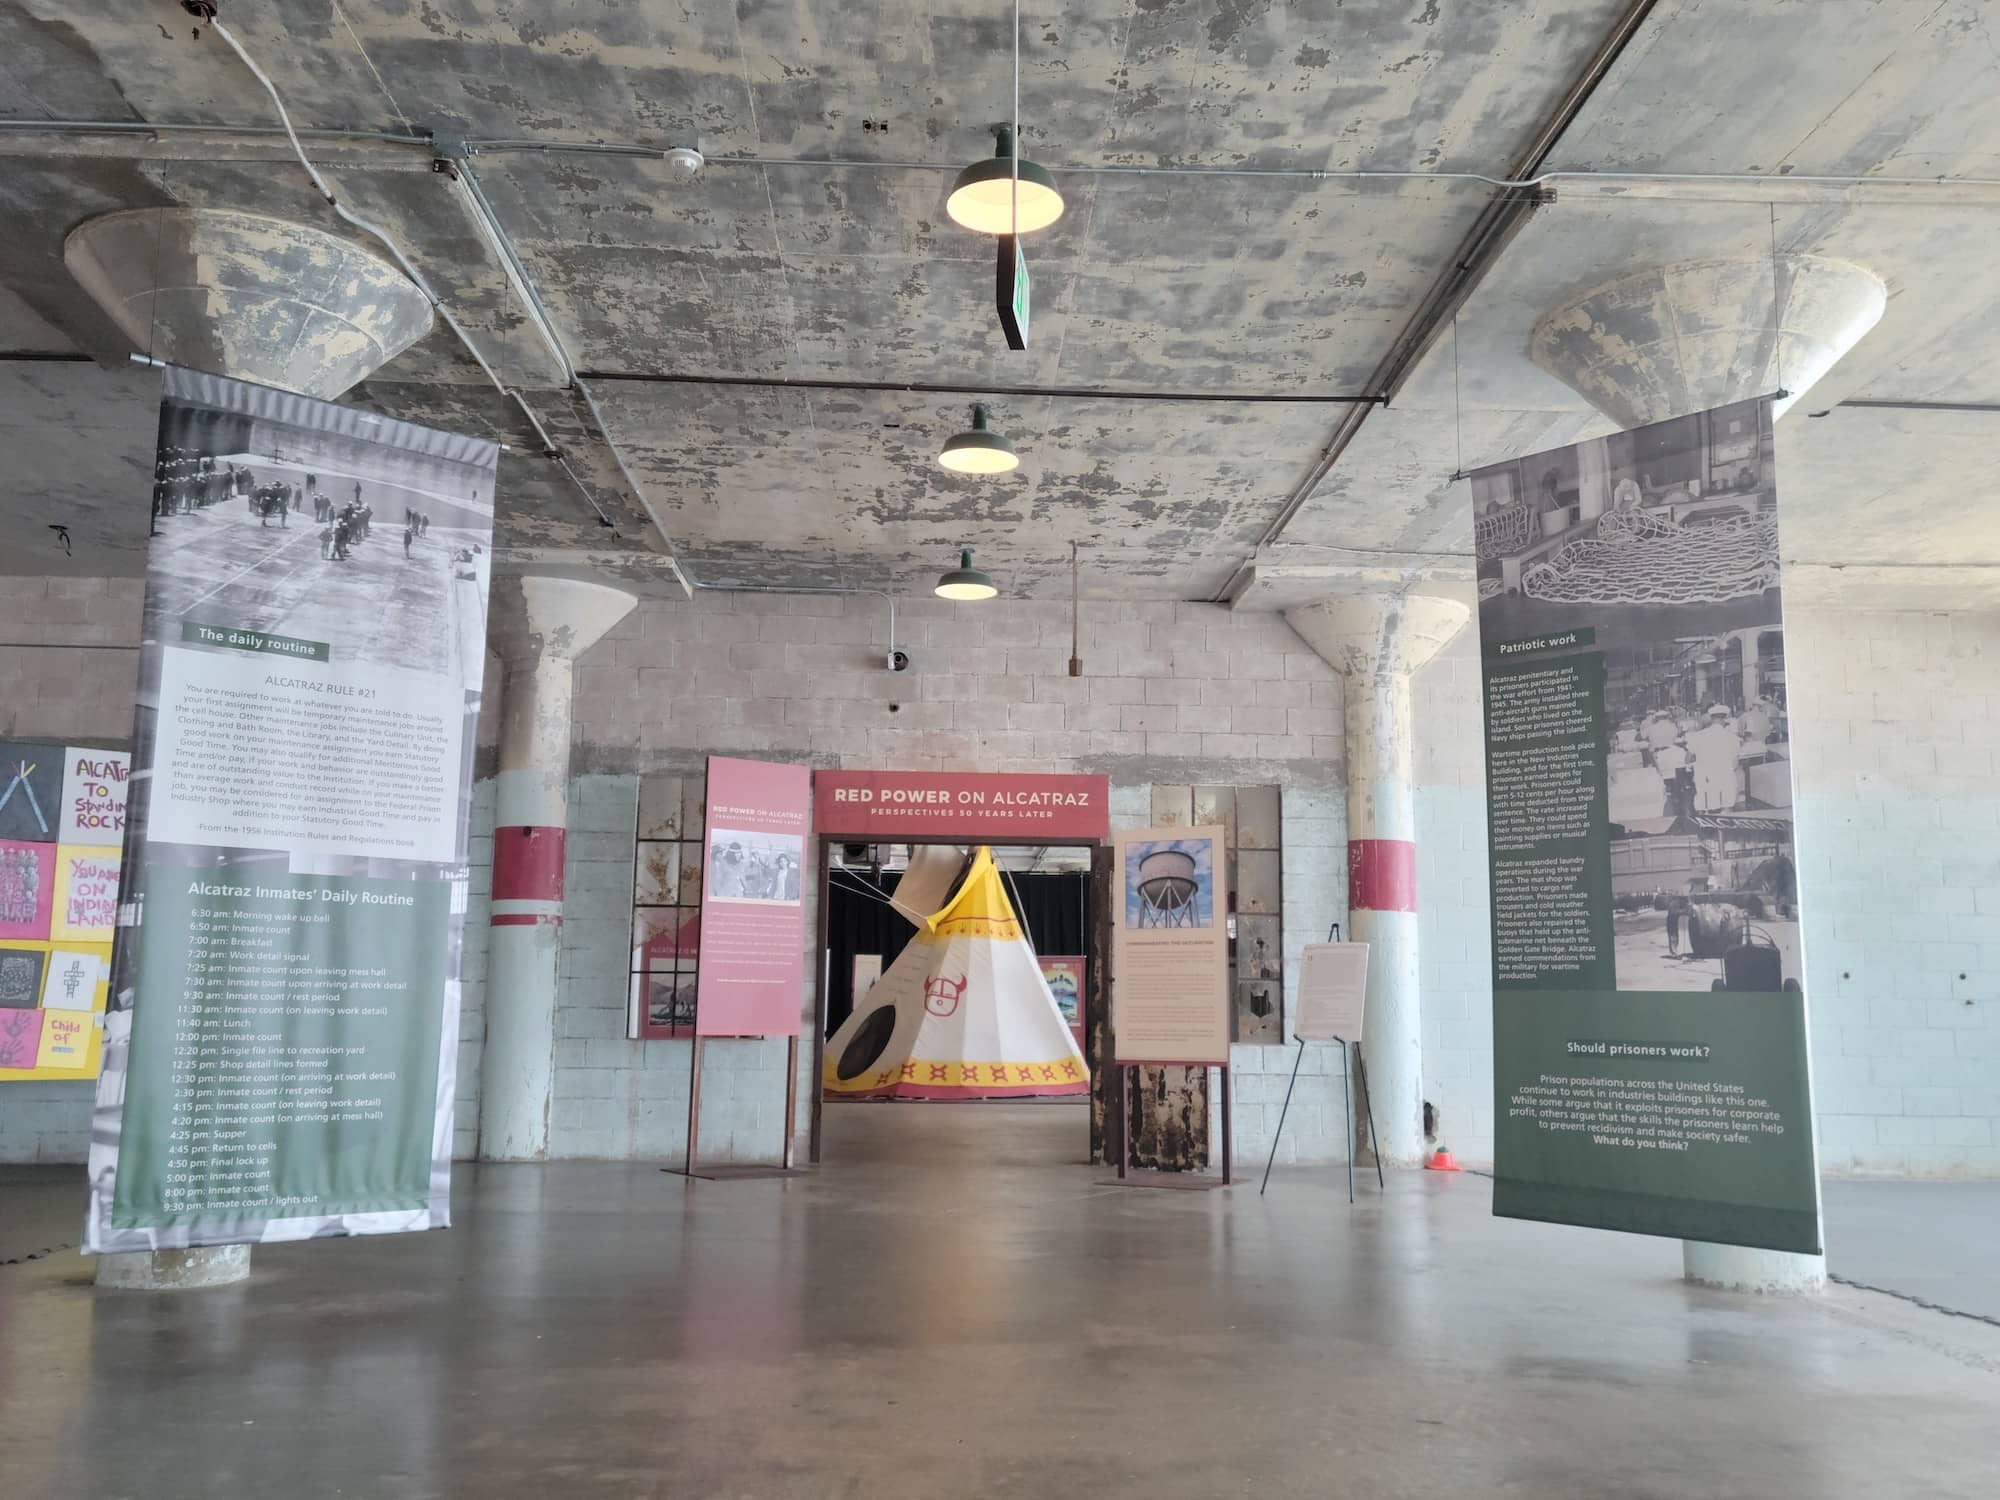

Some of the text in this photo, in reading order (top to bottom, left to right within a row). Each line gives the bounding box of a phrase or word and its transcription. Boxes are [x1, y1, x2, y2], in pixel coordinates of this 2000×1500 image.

[200, 627, 316, 655] The daily routine
[1499, 634, 1576, 654] Patriotic work
[1488, 666, 1574, 684] Alcatraz penitentiary and
[264, 674, 376, 698] ALCATRAZ RULE #21
[83, 782, 109, 798] TO
[834, 789, 1088, 806] RED POWER ON ALCATRAZ
[870, 808, 953, 816] PERSPECTIVES
[1019, 810, 1053, 818] LATER
[76, 813, 126, 831] ROCK
[77, 883, 106, 896] ON
[187, 882, 251, 898] Alcatraz
[321, 888, 358, 906] Daily
[361, 890, 414, 905] Routine
[67, 909, 114, 926] LAND
[231, 924, 264, 933] Inmate
[265, 925, 290, 934] count
[187, 950, 207, 958] 7:20
[229, 951, 254, 960] Work
[256, 952, 281, 960] detail
[283, 952, 310, 963] signal
[174, 1047, 198, 1056] 12:20
[221, 1047, 250, 1057] Single
[252, 1047, 266, 1055] file
[268, 1047, 285, 1055] line
[287, 1046, 297, 1055] to
[298, 1046, 344, 1054] recreation
[345, 1046, 365, 1056] yard
[1567, 1043, 1709, 1058] Should prisoners work?
[1539, 1075, 1744, 1093] Prison populations across the United States
[1518, 1086, 1769, 1107] continue to work in industries buildings like this one.
[1511, 1096, 1781, 1122] While some argue that it exploits prisoners for corporate
[1508, 1107, 1784, 1134] profit, others argue that the skills the prisoners learn help
[169, 1131, 190, 1140] 4:25
[213, 1129, 247, 1140] Supper
[1538, 1120, 1751, 1143] to prevent recidivism and make society safer.
[168, 1145, 189, 1153] 4:45
[211, 1143, 244, 1152] Return
[246, 1143, 257, 1151] to
[257, 1142, 277, 1151] cells
[1593, 1136, 1688, 1150] What do you think?
[167, 1159, 188, 1168] 4:50
[210, 1157, 233, 1166] Final
[235, 1157, 254, 1165] lock
[256, 1158, 268, 1166] up
